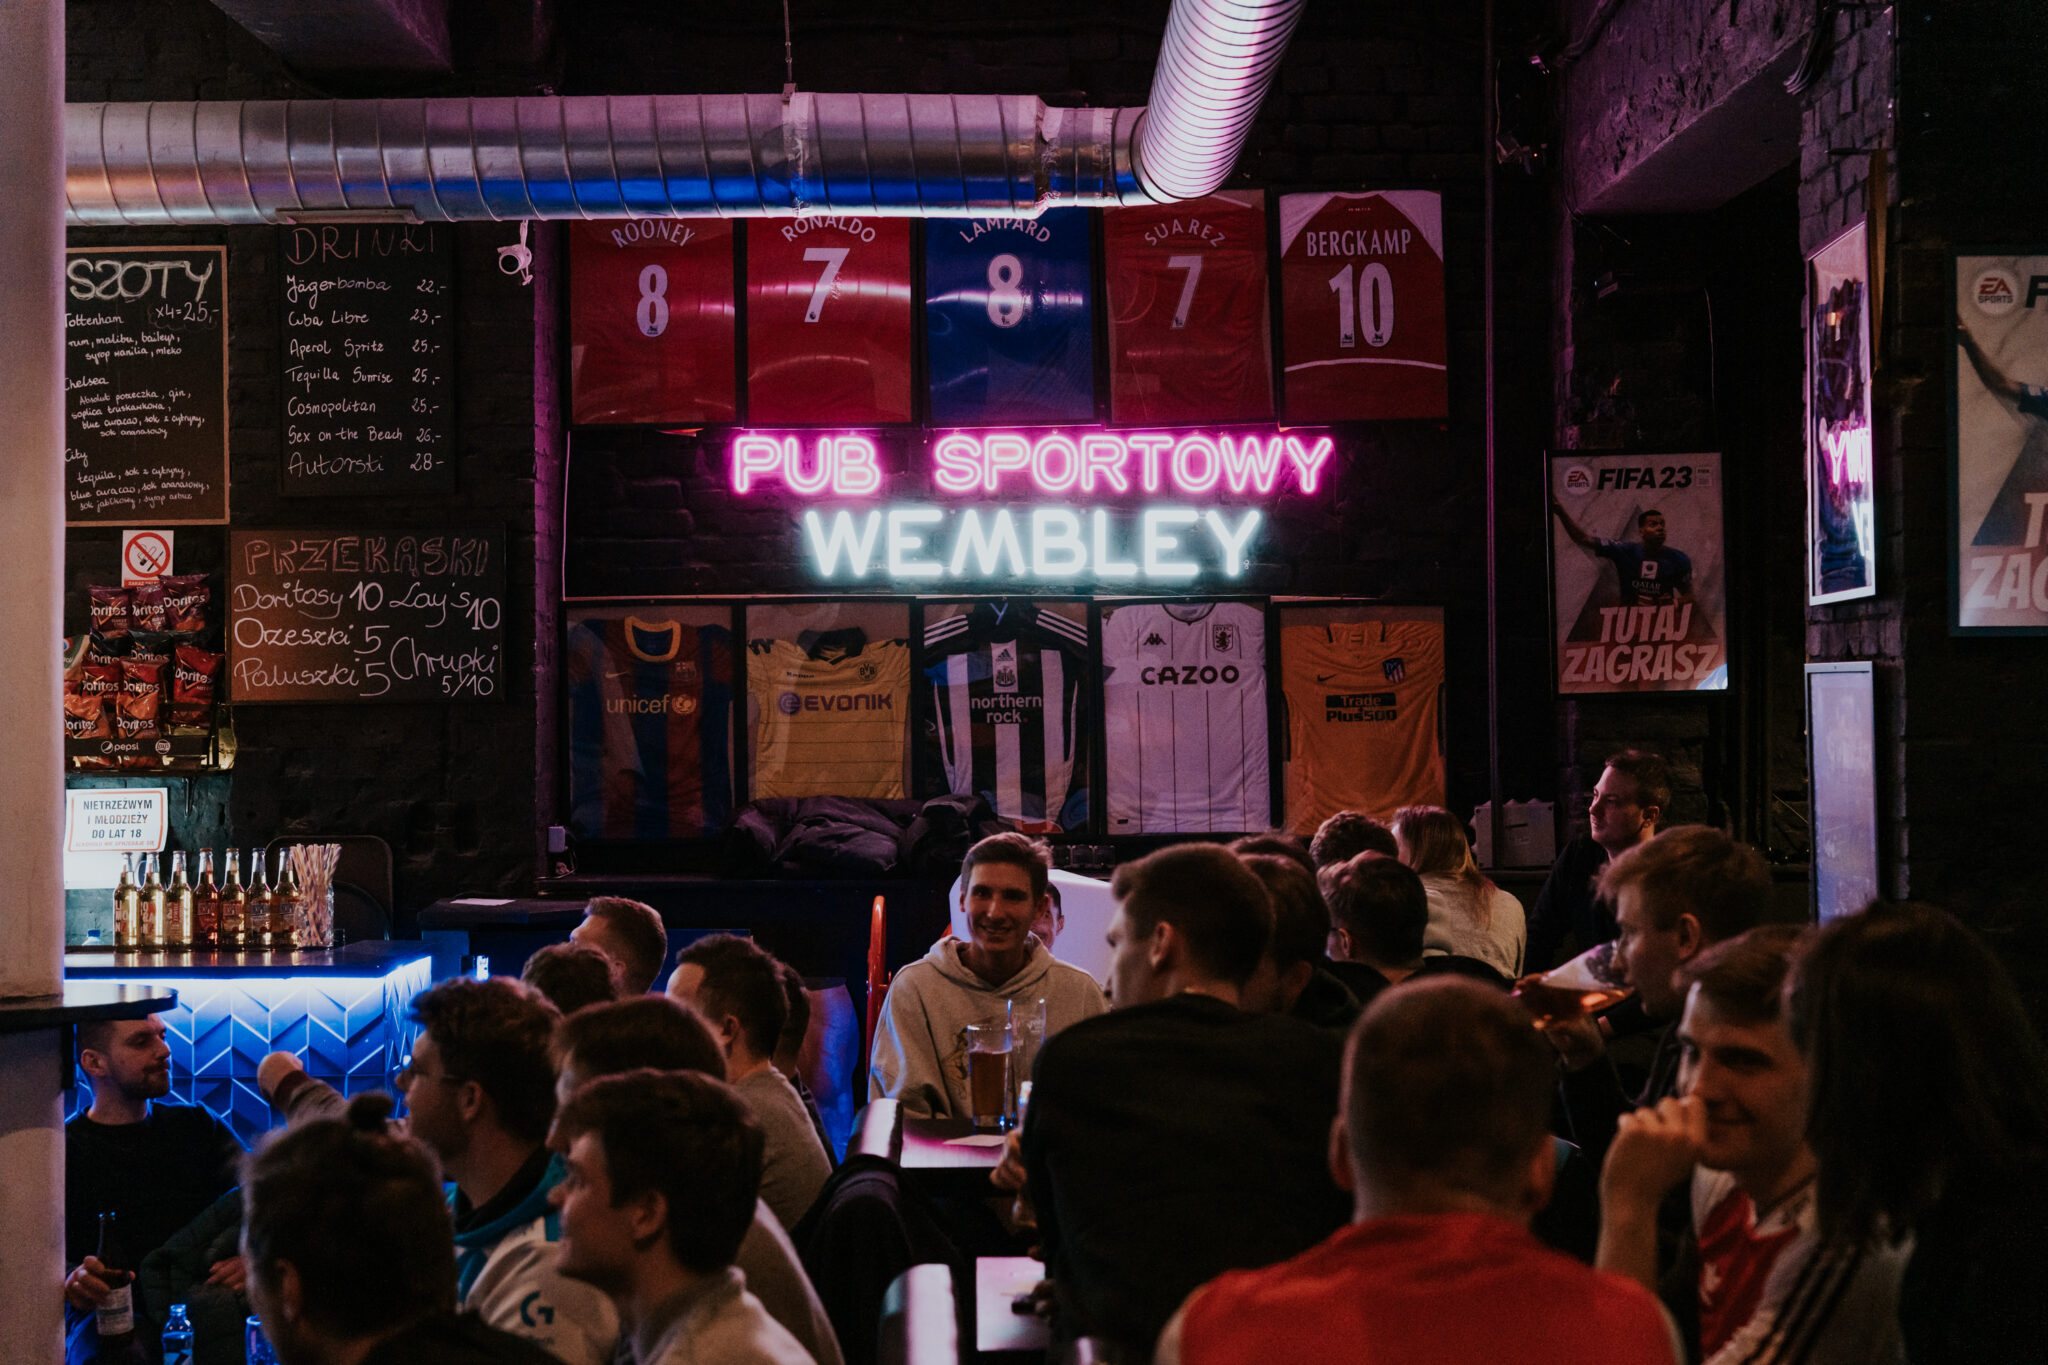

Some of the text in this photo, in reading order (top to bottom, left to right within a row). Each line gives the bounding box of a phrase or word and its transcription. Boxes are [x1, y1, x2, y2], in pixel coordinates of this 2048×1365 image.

[612, 218, 695, 249] ROONEY
[781, 216, 876, 242] RONALDO
[960, 219, 1051, 243] LAMPARD
[1144, 219, 1227, 248] SUAREZ
[1306, 229, 1412, 257] BERGKAMP
[802, 247, 851, 323] 7
[986, 253, 1024, 329] 8
[1167, 254, 1204, 330] 7
[1979, 277, 2011, 294] EA
[636, 264, 669, 337] 8
[1328, 262, 1395, 348] 10
[1978, 295, 2014, 304] SPORTS
[289, 311, 323, 326] Cuba
[331, 310, 369, 324] Libre
[290, 338, 332, 360] Aperol
[287, 396, 376, 418] Cosmopolitan
[100, 428, 116, 437] sok
[288, 424, 310, 444] Sex
[319, 430, 331, 441] on
[335, 428, 359, 440] the
[366, 425, 402, 442] Beach
[731, 434, 1334, 495] PUB SPORTOWY
[1567, 470, 1589, 482] EA
[1597, 466, 1693, 490] FIFA 23
[804, 507, 1263, 578] WEMBLEY
[162, 595, 206, 608] Doritos
[349, 581, 384, 611] 10
[465, 597, 501, 631] 10
[1600, 603, 1693, 643] TUTAJ
[353, 625, 390, 654] 5
[389, 636, 499, 682] Chrupki
[1561, 643, 1720, 684] ZAGRASZ
[234, 657, 391, 697] Paluszki 5
[441, 672, 494, 697] 5/10
[1141, 665, 1240, 685] CAZOO
[606, 693, 671, 714] unicef
[804, 693, 892, 712] EVONIK
[970, 694, 1042, 710] northern
[1340, 695, 1383, 707] Trade
[1326, 710, 1398, 722] Plus500
[114, 742, 139, 752] pepsi
[92, 829, 142, 839] DO LAT 18
